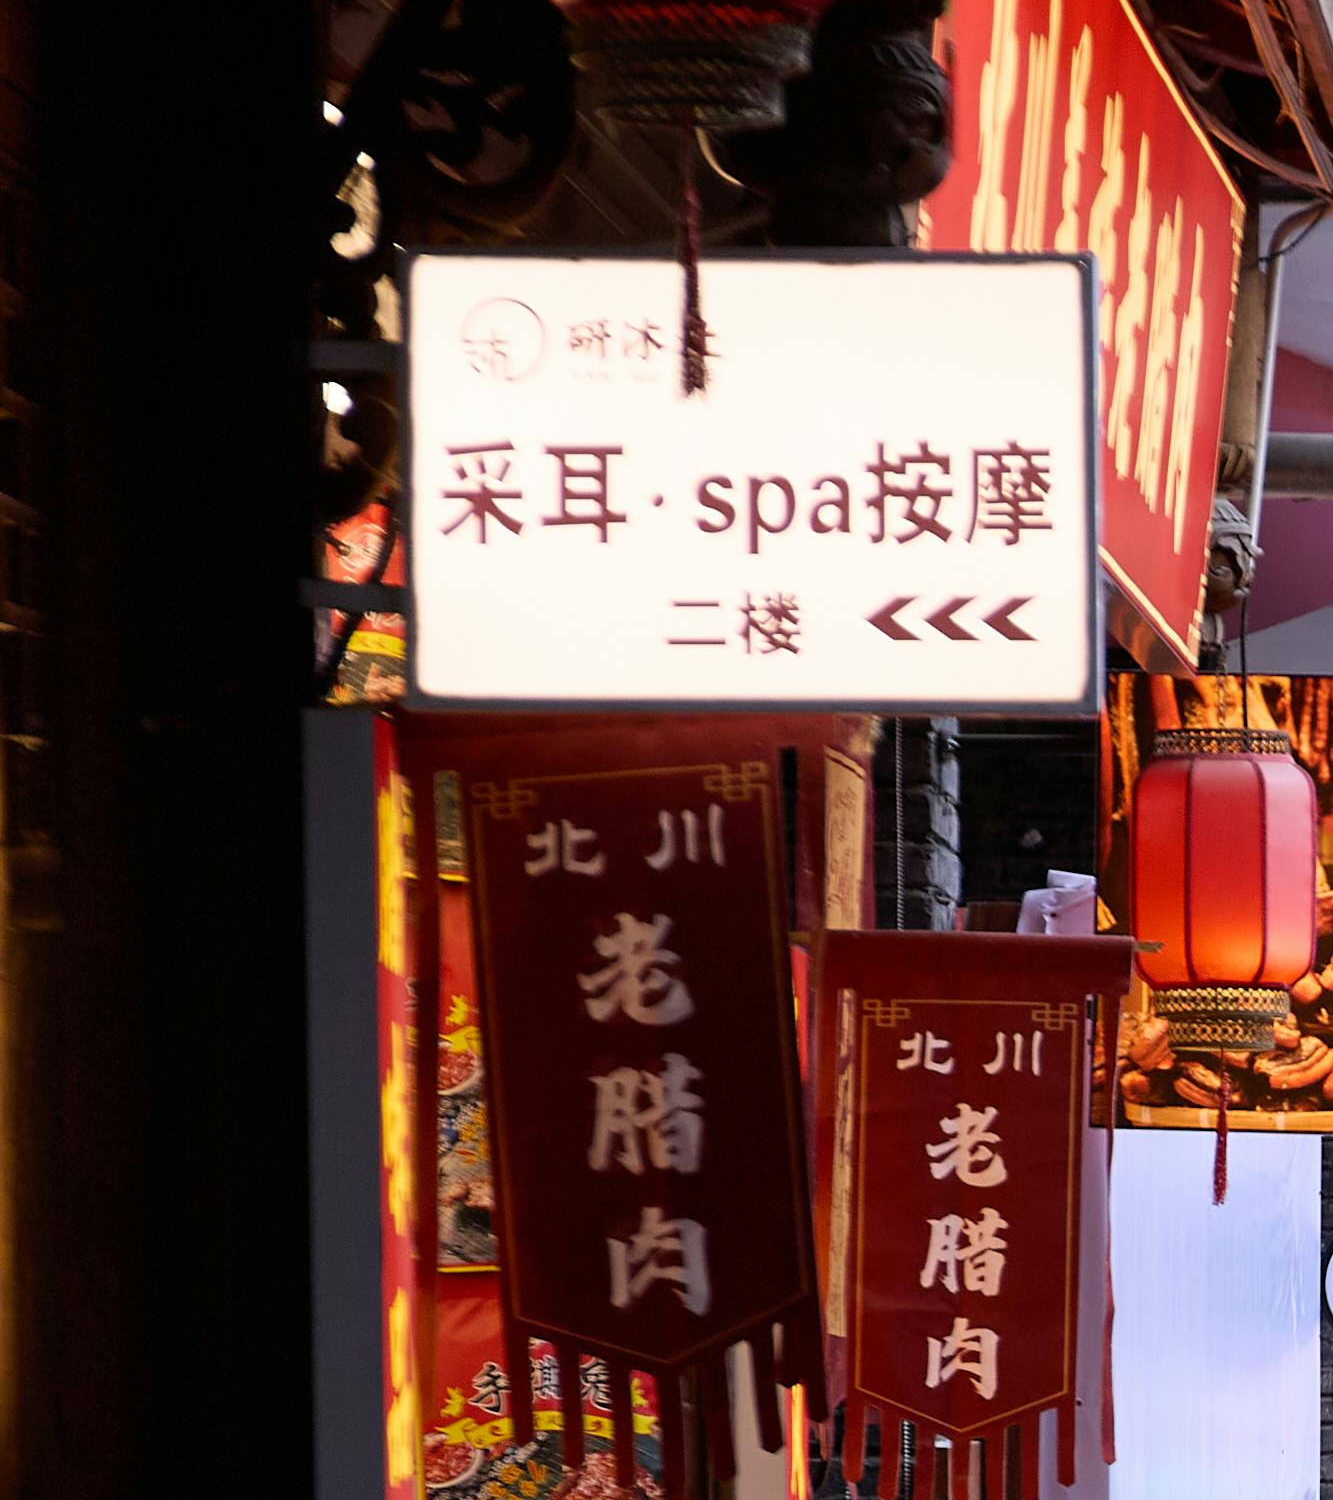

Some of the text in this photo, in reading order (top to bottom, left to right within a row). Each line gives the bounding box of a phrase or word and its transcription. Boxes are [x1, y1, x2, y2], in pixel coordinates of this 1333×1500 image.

[666, 593, 802, 655] 二楼
[525, 804, 728, 877] 北川
[897, 1030, 1043, 1076] 北川
[576, 912, 711, 1317] 老腊肉
[919, 1103, 1009, 1401] 老腊肉
